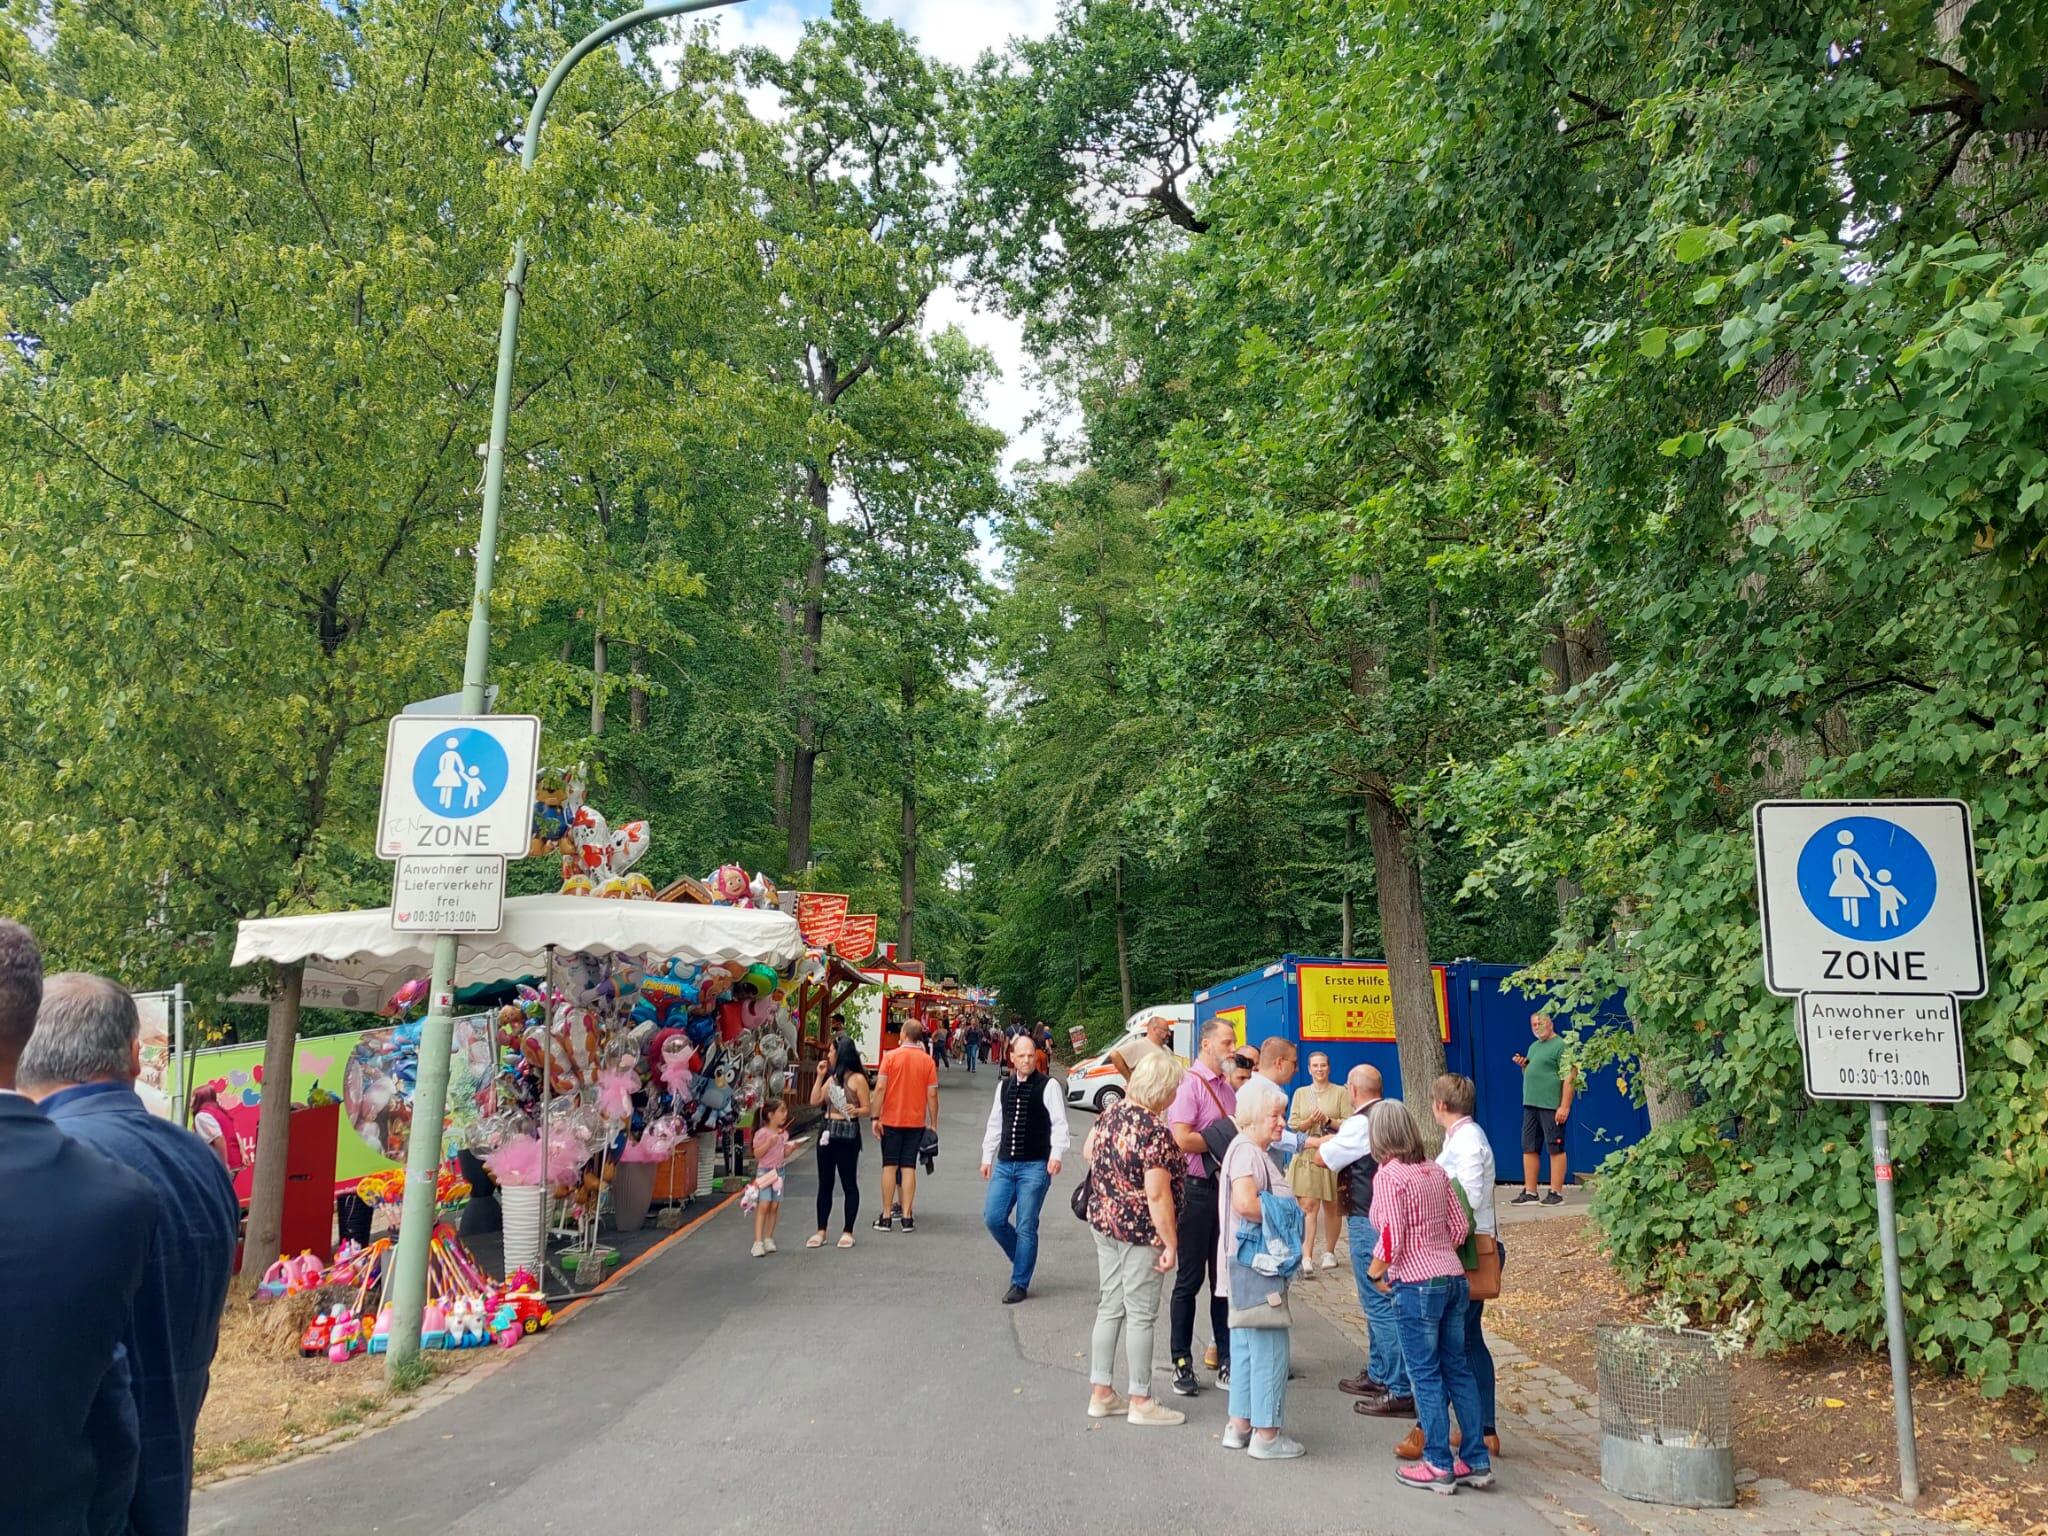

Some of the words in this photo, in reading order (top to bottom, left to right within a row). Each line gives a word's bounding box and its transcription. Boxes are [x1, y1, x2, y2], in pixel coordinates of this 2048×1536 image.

[417, 825, 491, 847] ZONE
[404, 864, 469, 874] Anwohner
[476, 864, 499, 874] und
[404, 880, 493, 890] Lieferverkehr
[437, 896, 459, 906] frei
[413, 910, 476, 922] 00:30-13:00h
[1821, 950, 1928, 981] ZONE
[1325, 976, 1354, 986] Erste
[1358, 975, 1384, 986] Hilfe
[1333, 995, 1358, 1004] First
[1361, 994, 1380, 1004] Aid
[1812, 1003, 1905, 1019] Anwohner
[1916, 1005, 1949, 1020] und
[1817, 1025, 1945, 1042] Lieferverkehr
[1868, 1048, 1899, 1064] frei
[1839, 1068, 1930, 1086] 00:30-13:00h
